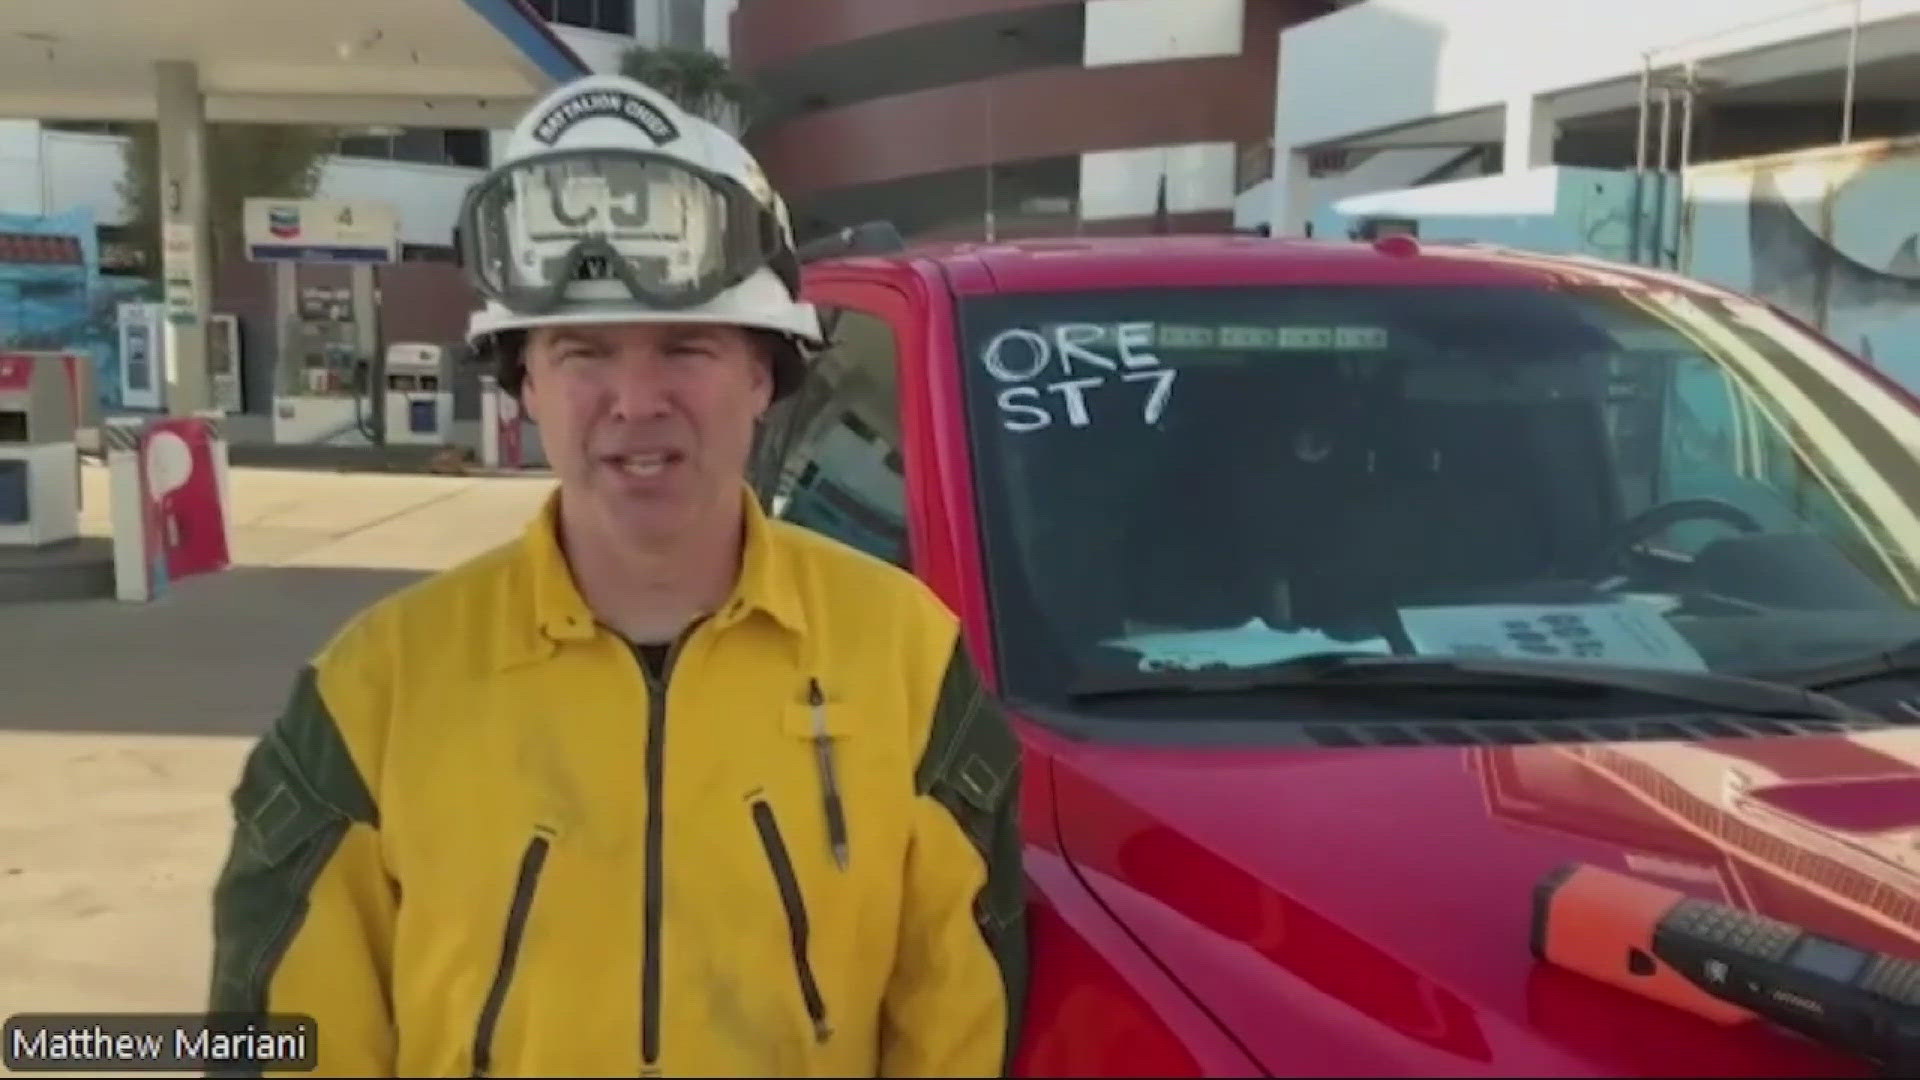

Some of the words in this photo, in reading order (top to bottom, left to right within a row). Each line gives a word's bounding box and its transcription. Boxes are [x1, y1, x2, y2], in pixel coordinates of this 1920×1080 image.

[538, 93, 622, 142] BATTALION
[983, 320, 1160, 382] ORE
[997, 376, 1106, 433] ST
[1121, 368, 1178, 426] 7
